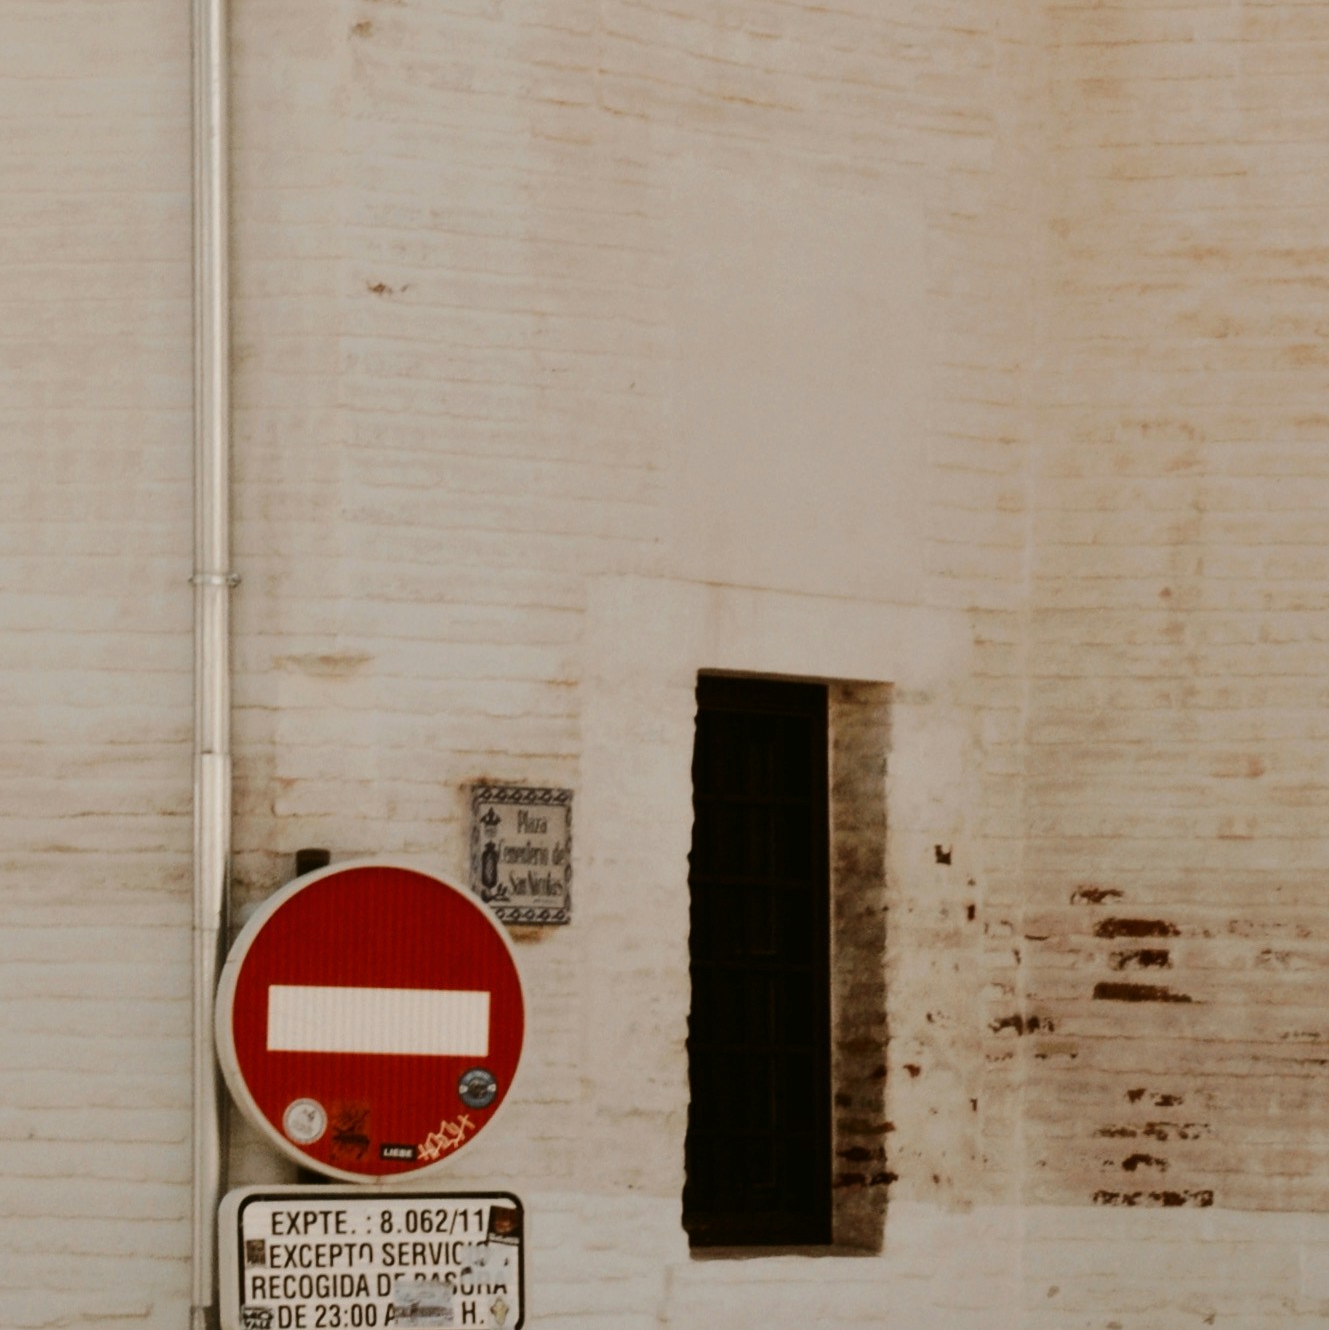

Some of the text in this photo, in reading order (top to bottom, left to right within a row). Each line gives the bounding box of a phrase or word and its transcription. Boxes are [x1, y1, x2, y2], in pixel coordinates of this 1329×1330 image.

[517, 809, 548, 835] Plaza
[383, 1147, 413, 1158] LIEBE
[380, 1208, 483, 1235] 8.062/11
[251, 1273, 370, 1300] RECOGIDA
[278, 1304, 307, 1329] DE
[315, 1302, 377, 1329] 23:00
[462, 1300, 485, 1325] H.
